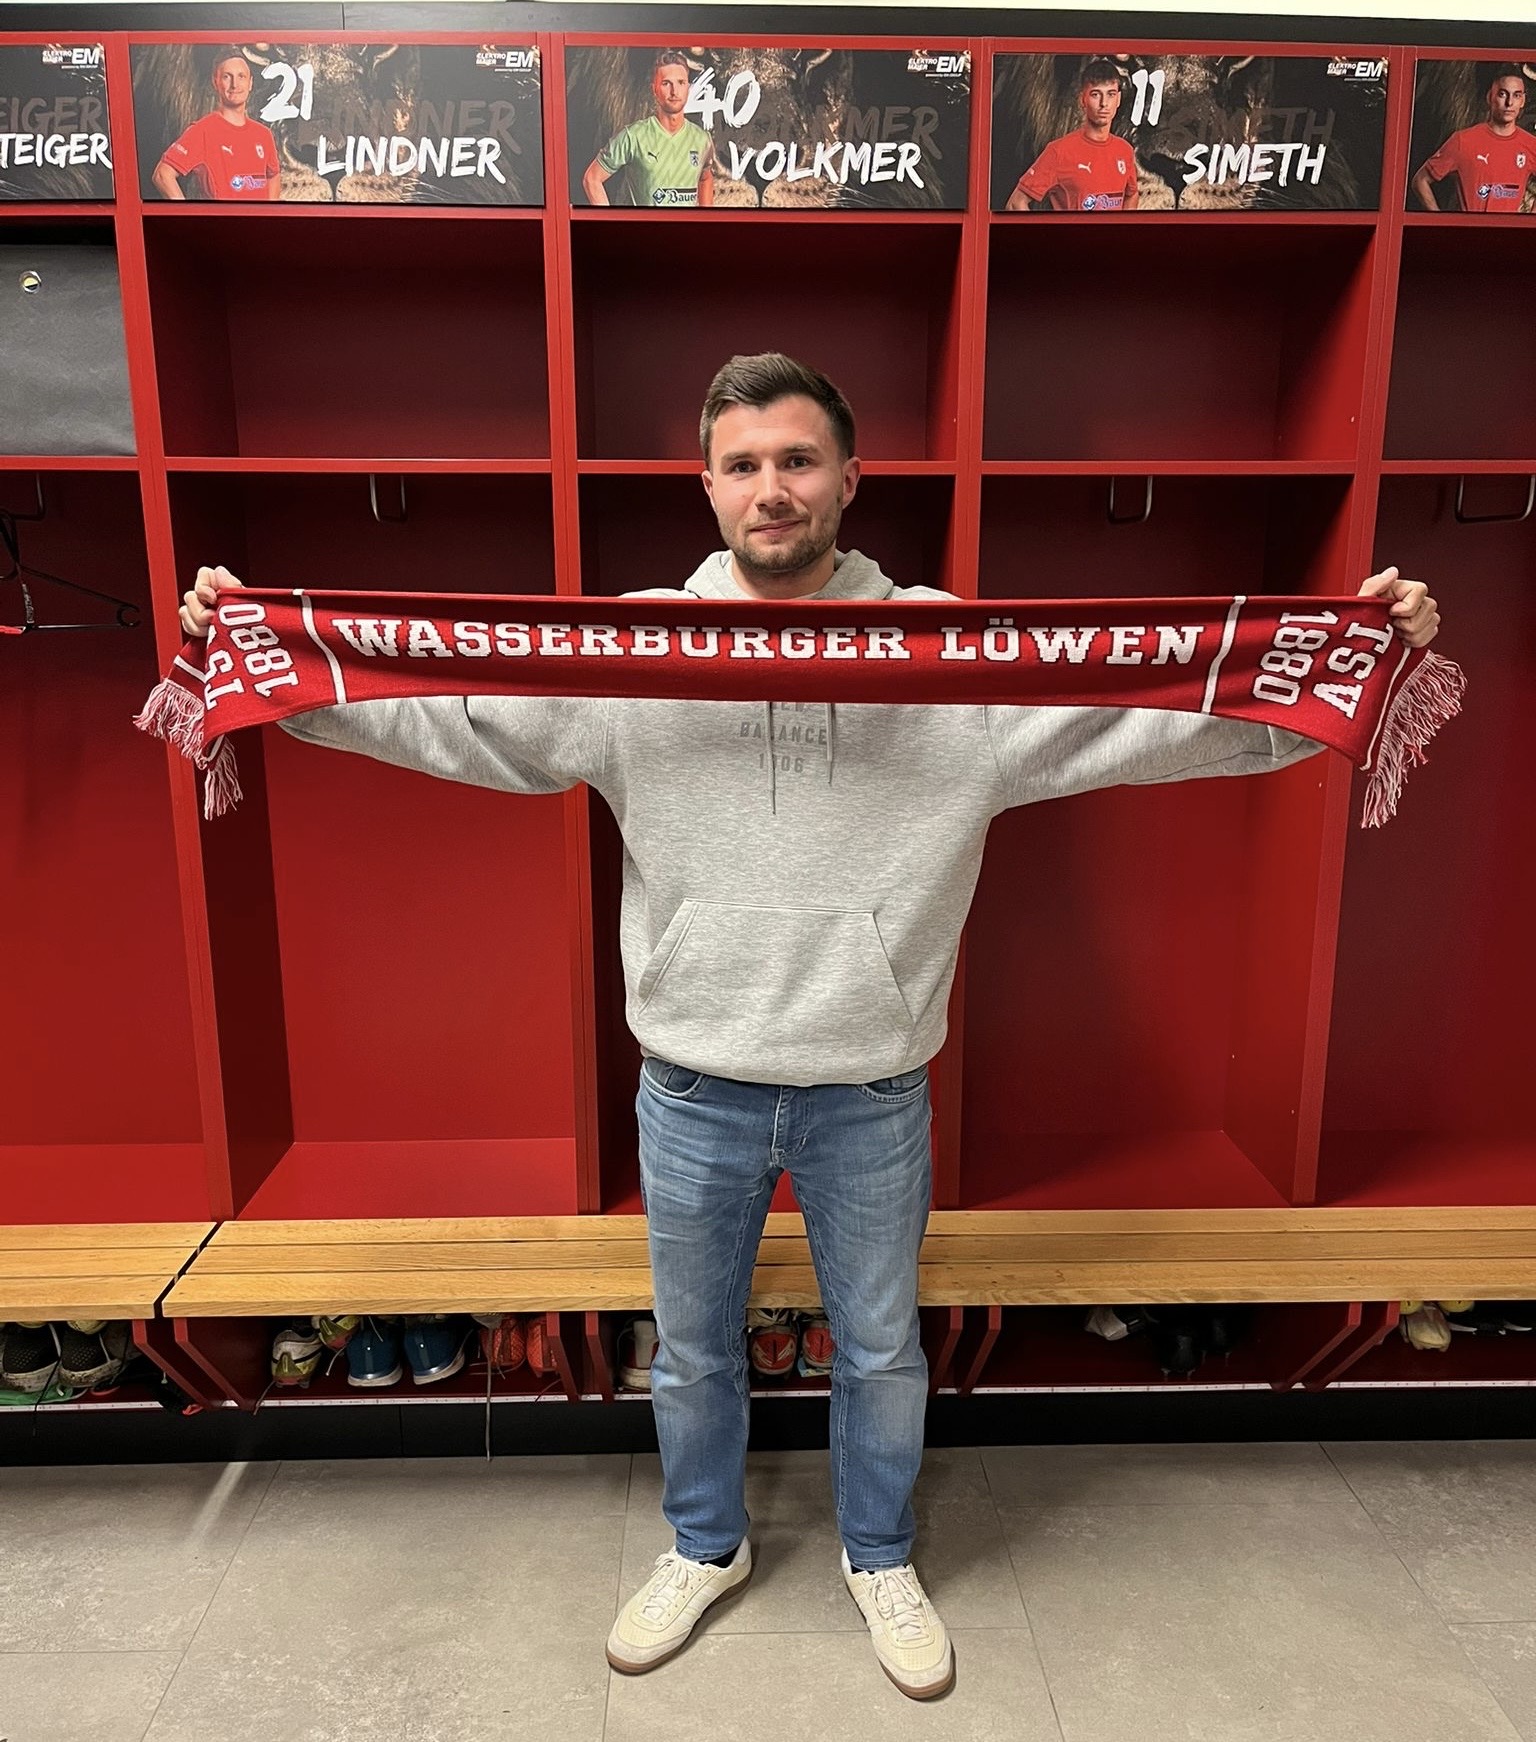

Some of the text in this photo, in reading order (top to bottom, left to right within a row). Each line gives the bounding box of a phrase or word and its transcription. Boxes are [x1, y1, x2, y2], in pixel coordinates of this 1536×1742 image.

[72, 48, 100, 64] EM
[505, 51, 534, 68] EM
[936, 56, 966, 73] EM
[1354, 61, 1384, 77] EM
[260, 61, 314, 122] 21
[683, 66, 761, 130] 40
[1131, 69, 1167, 126] 11
[317, 134, 507, 184] LINDNER
[728, 140, 924, 189] VOLKMER
[1182, 142, 1327, 188] SIMETH
[218, 603, 299, 698] 1880
[332, 617, 1204, 665] WASSERBURGER LÖWEN
[1252, 610, 1339, 706] 1880
[204, 624, 245, 711] TS
[1312, 622, 1394, 721] TSV
[740, 721, 828, 746] BAANCE
[759, 752, 805, 774] 106
